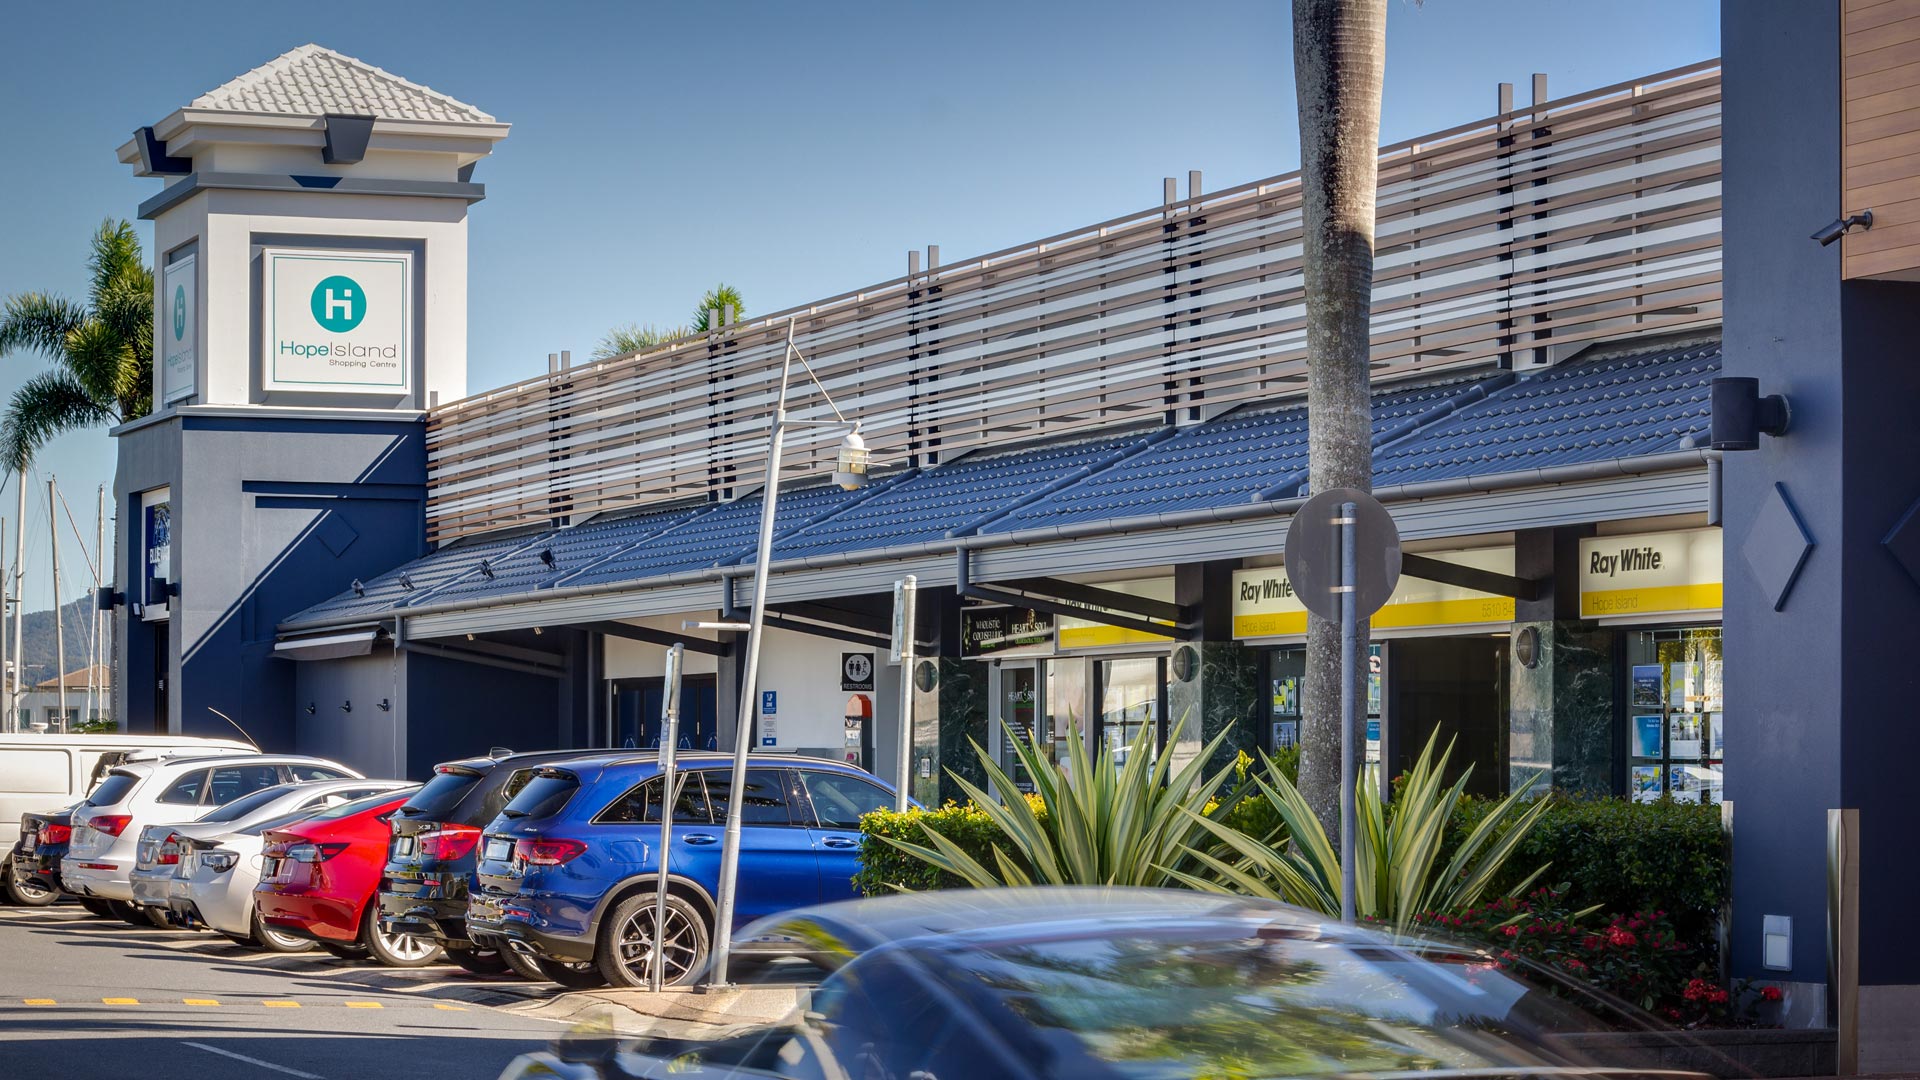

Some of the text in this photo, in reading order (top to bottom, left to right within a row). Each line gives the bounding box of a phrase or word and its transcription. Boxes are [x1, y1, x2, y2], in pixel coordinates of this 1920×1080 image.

[329, 359, 367, 369] Shopping
[1590, 547, 1662, 578] Ray White
[1240, 578, 1293, 604] Ray White
[1592, 593, 1638, 613] Hope Island
[1011, 622, 1030, 634] HEART
